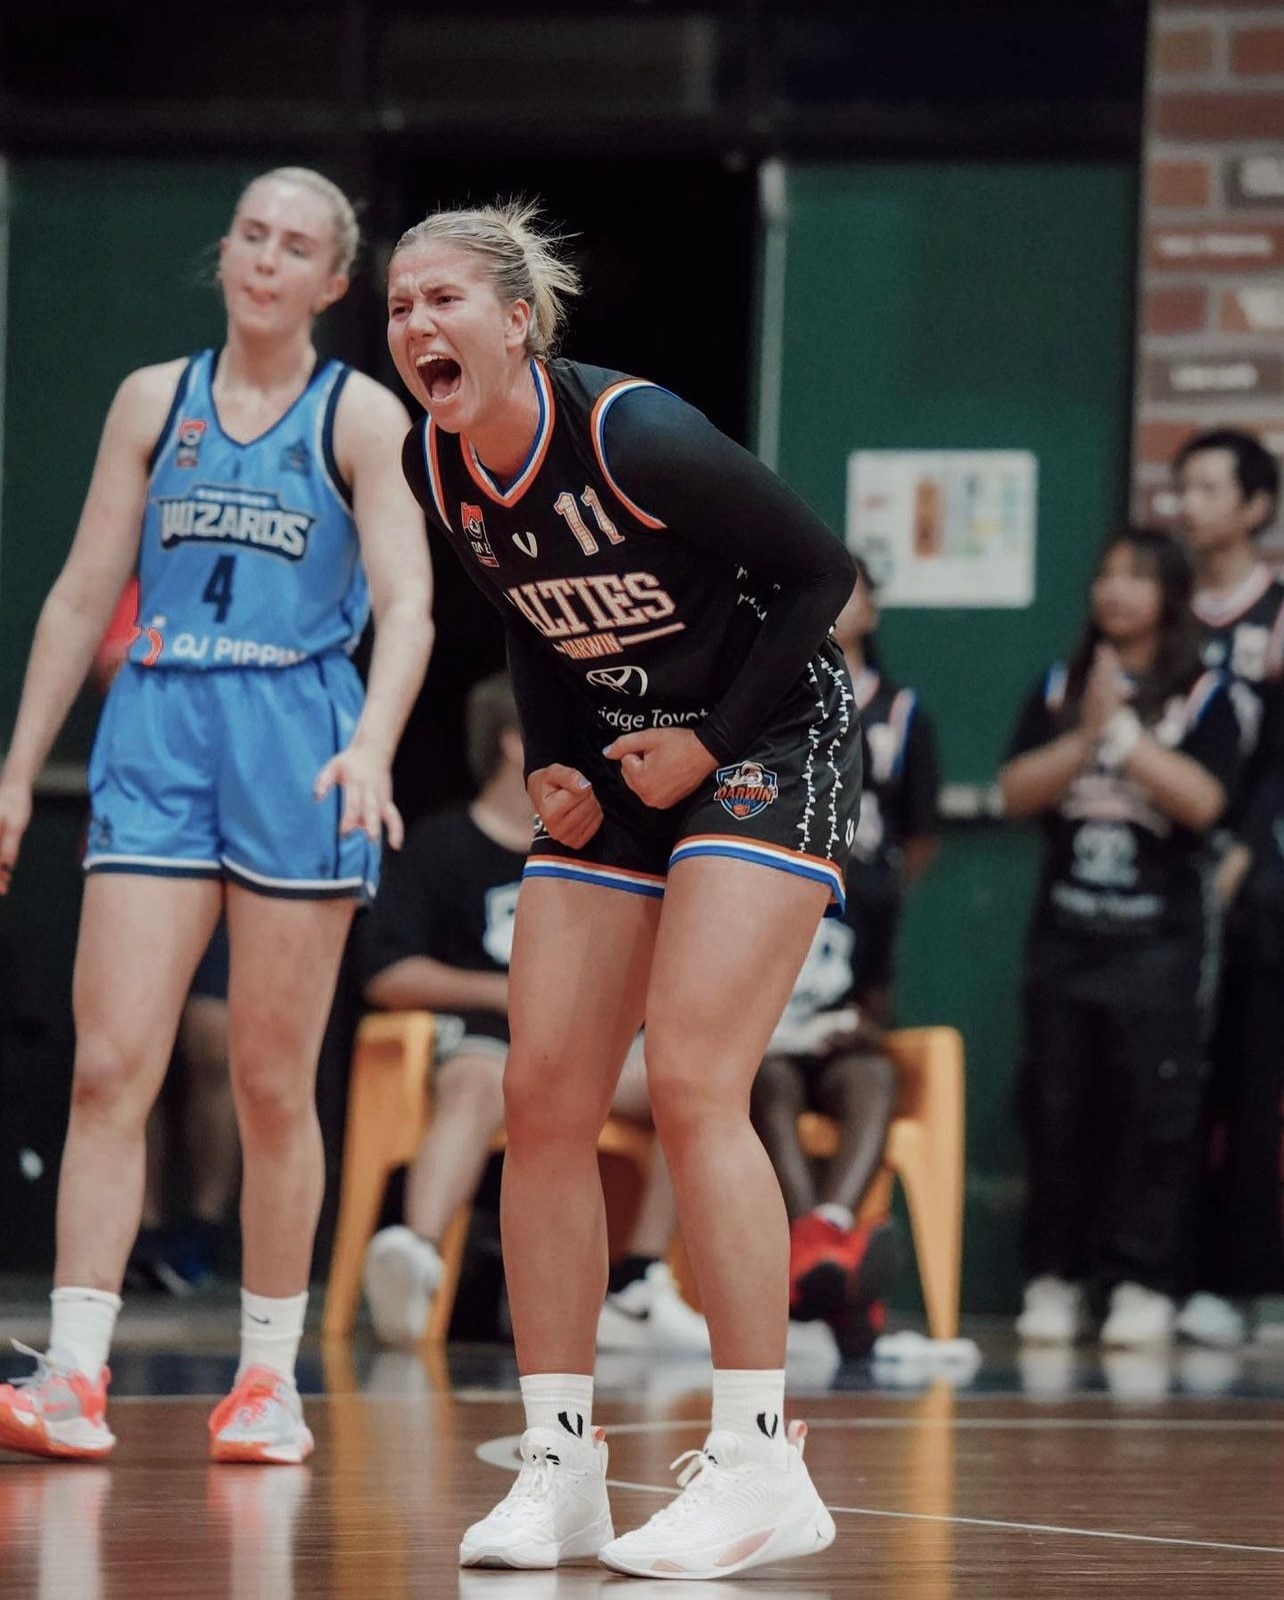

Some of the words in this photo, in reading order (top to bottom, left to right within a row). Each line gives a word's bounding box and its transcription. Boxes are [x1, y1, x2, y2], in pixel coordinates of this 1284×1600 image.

[161, 499, 311, 557] WIZARDS
[553, 485, 625, 556] 11
[202, 555, 236, 624] 4
[503, 571, 677, 638] ALTIES
[598, 706, 645, 731] idge
[717, 785, 774, 802] DARWIN
